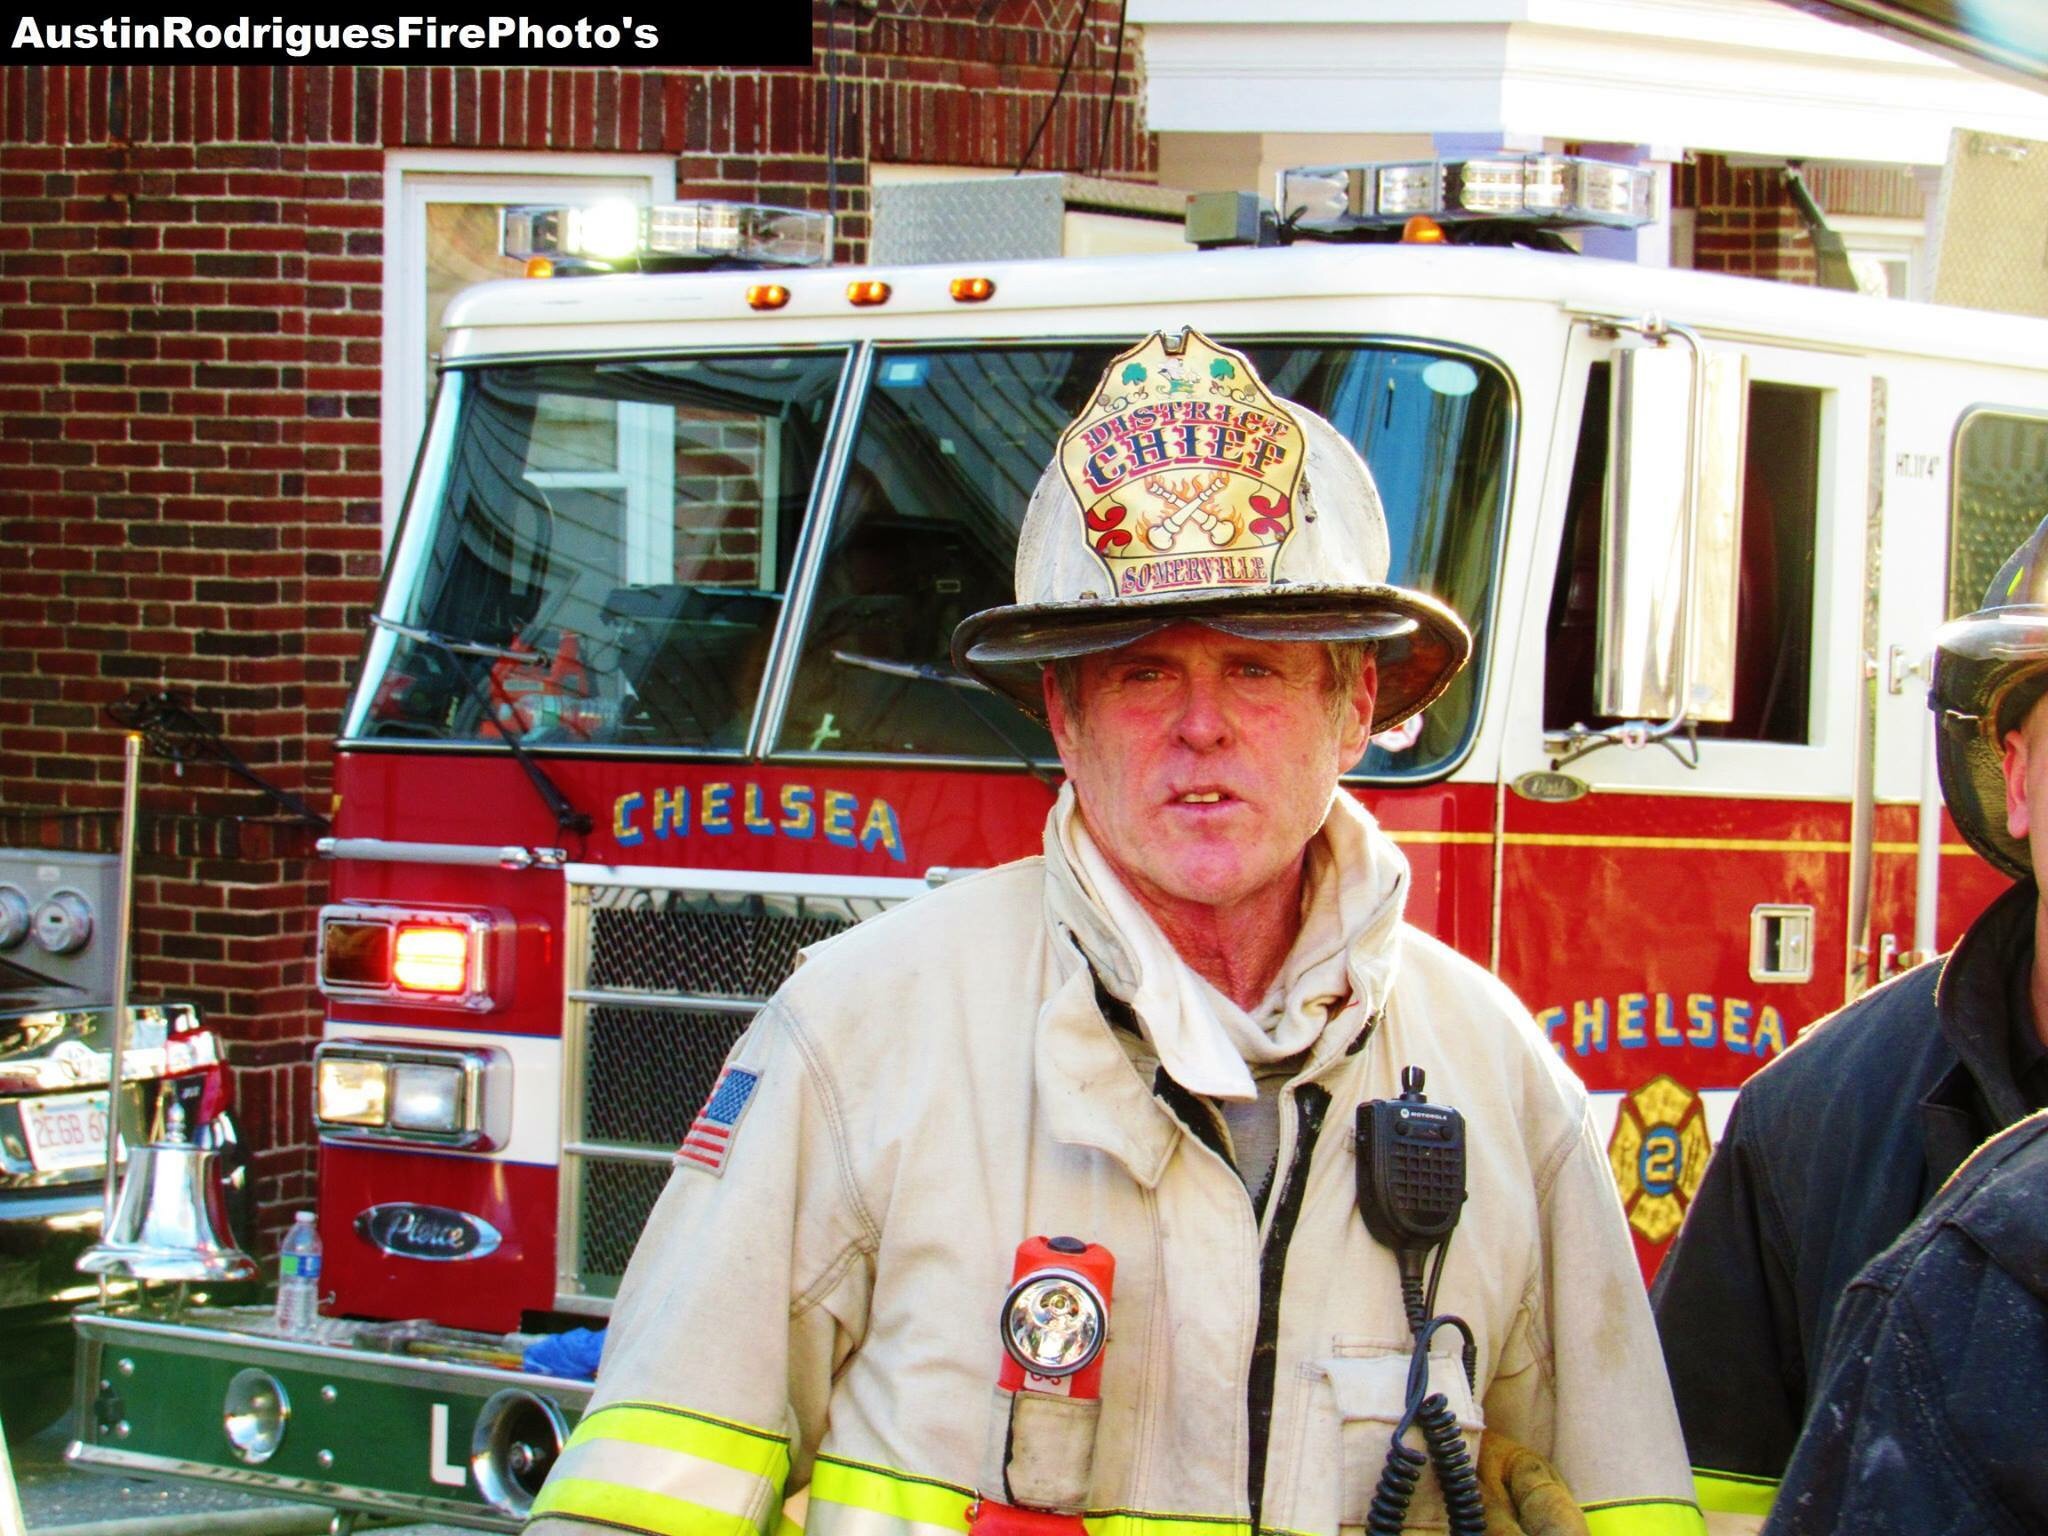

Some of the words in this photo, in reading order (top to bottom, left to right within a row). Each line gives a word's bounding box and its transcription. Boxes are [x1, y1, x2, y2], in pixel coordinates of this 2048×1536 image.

[1080, 400, 1289, 454] DISTRICT
[1081, 422, 1291, 496] CHIEF
[1121, 554, 1268, 593] SOMERVILLE
[613, 782, 907, 862] CHELSEA
[1536, 993, 1786, 1058] CHELSEA
[1410, 1111, 1448, 1121] MOTOROLA
[1645, 1136, 1676, 1182] 2
[386, 1208, 465, 1249] Pierce
[431, 1403, 466, 1486] L
